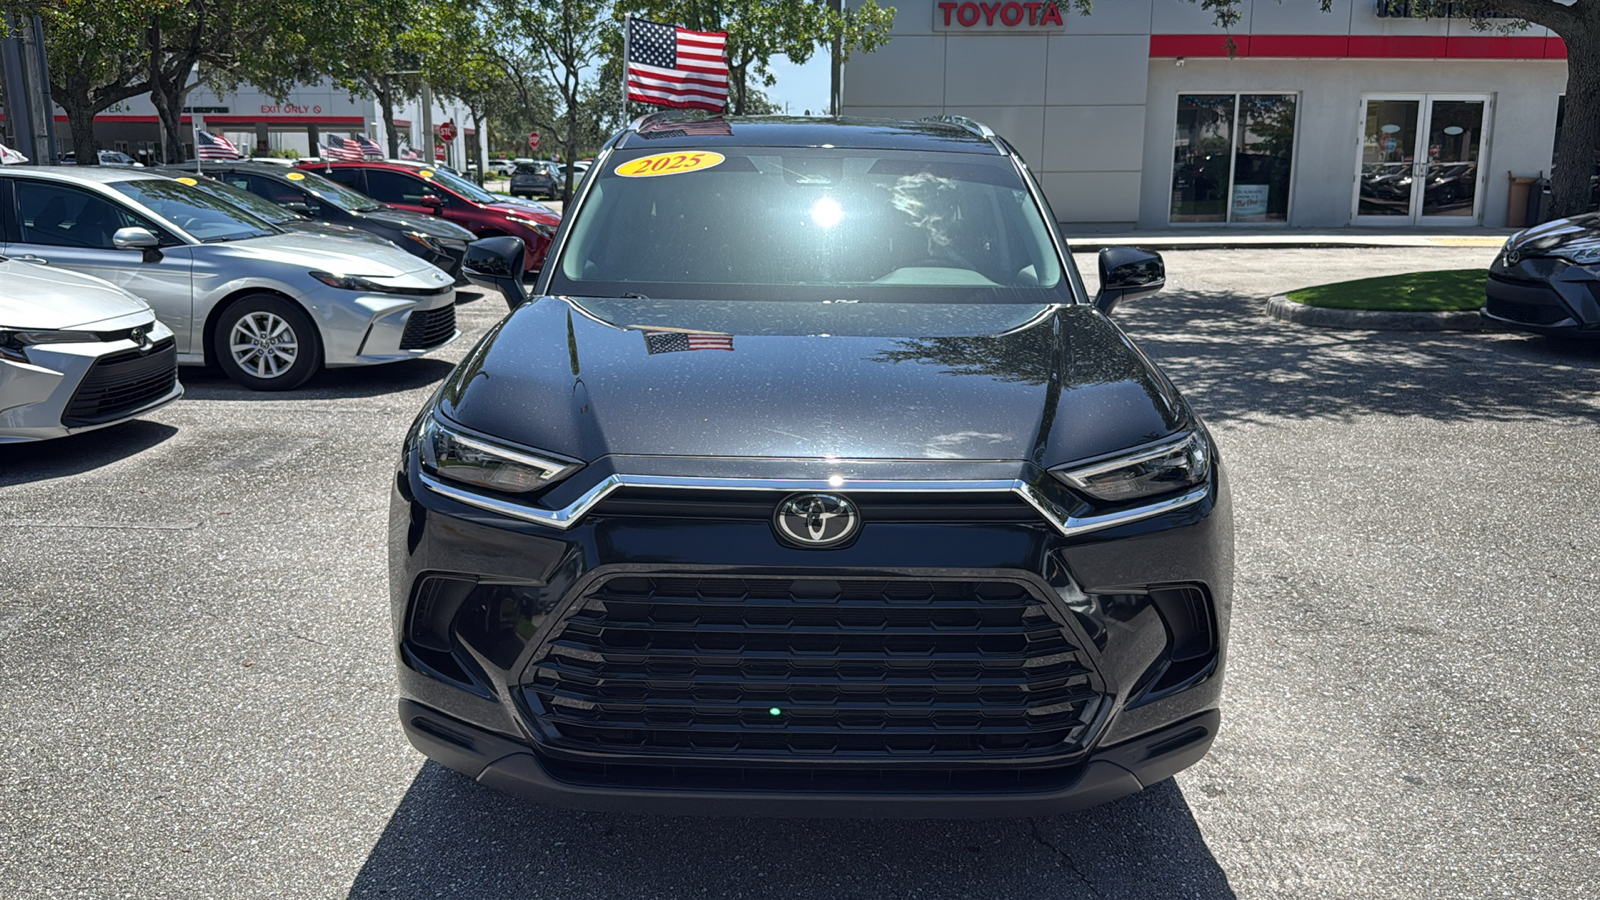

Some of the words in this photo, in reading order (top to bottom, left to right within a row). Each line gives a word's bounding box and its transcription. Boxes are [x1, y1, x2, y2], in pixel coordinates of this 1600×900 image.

[938, 2, 1063, 27] TOYOTA
[261, 105, 280, 114] EXIT
[284, 105, 309, 114] ONLY
[631, 153, 706, 175] 2025
